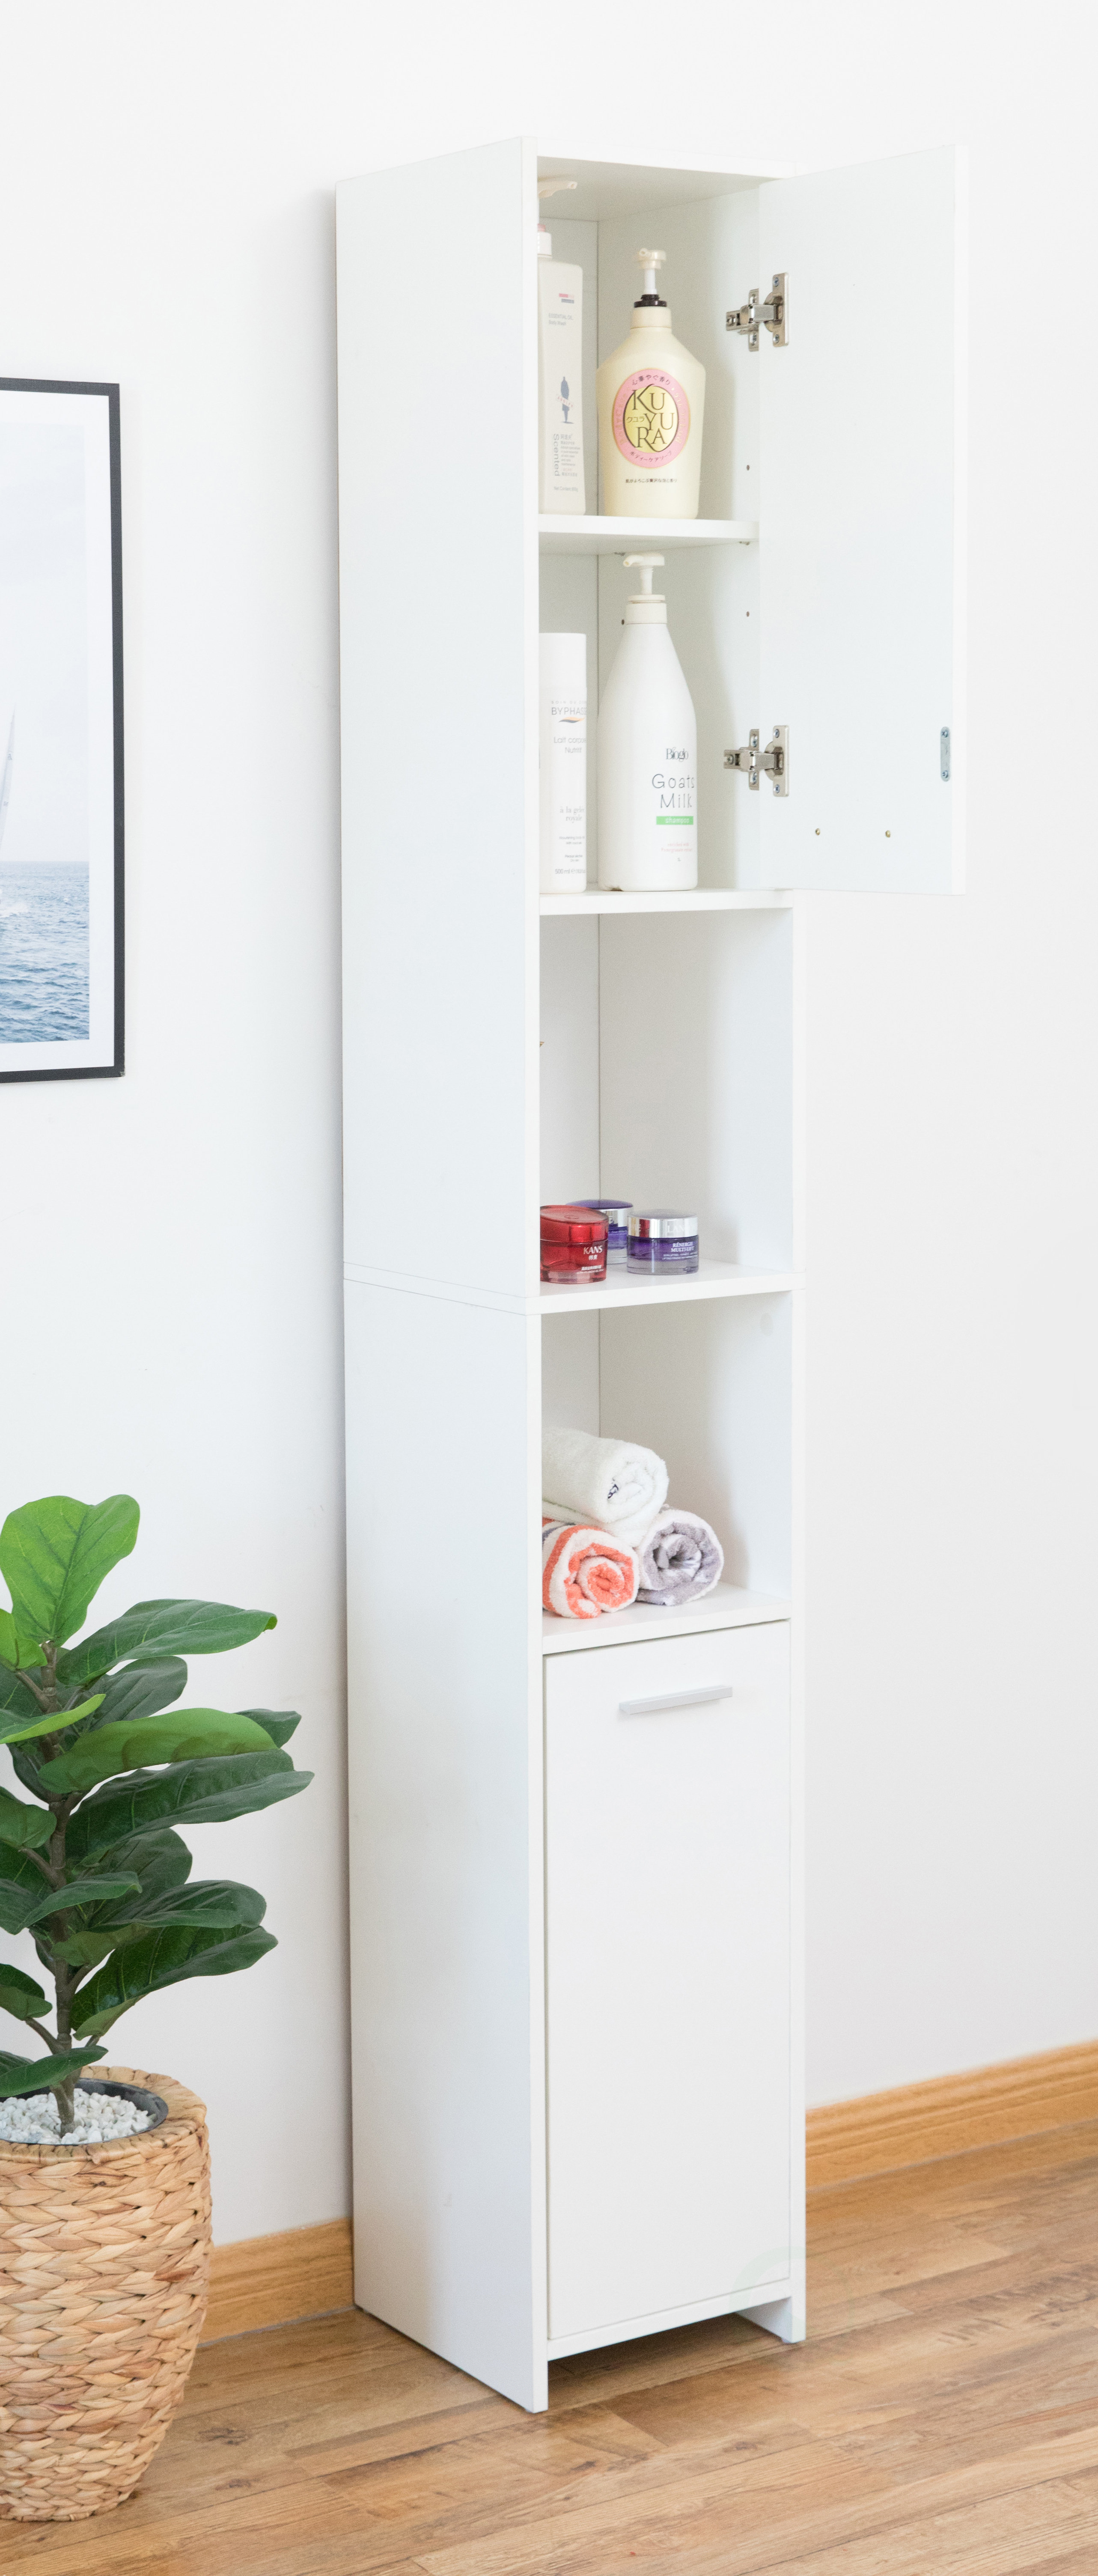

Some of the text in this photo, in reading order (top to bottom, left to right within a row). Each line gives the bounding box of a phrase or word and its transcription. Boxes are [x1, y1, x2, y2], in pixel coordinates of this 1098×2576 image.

[652, 774, 694, 789] Goats
[661, 793, 692, 808] Milk
[583, 1245, 603, 1255] KANS
